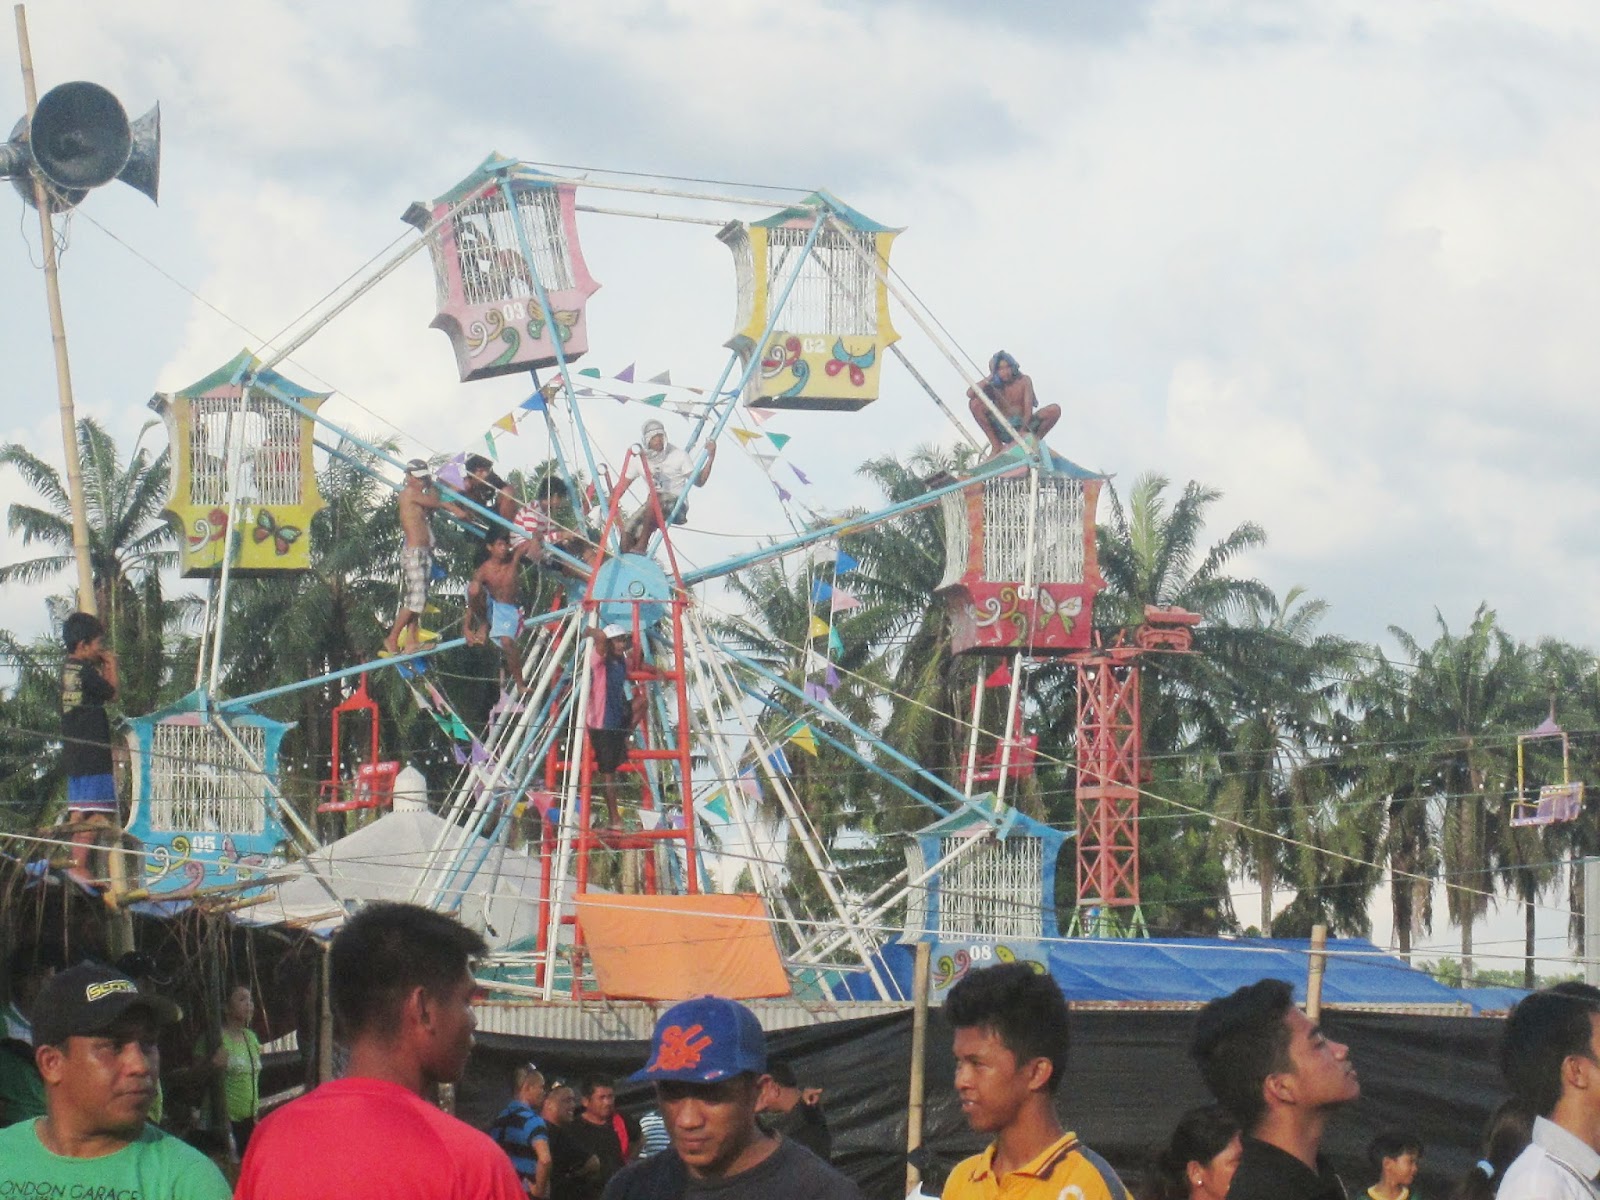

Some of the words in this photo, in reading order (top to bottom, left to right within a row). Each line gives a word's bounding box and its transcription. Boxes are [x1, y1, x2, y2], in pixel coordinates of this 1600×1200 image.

[503, 303, 526, 321] 03
[804, 338, 826, 353] 02
[192, 835, 216, 853] 05
[970, 945, 992, 960] 08
